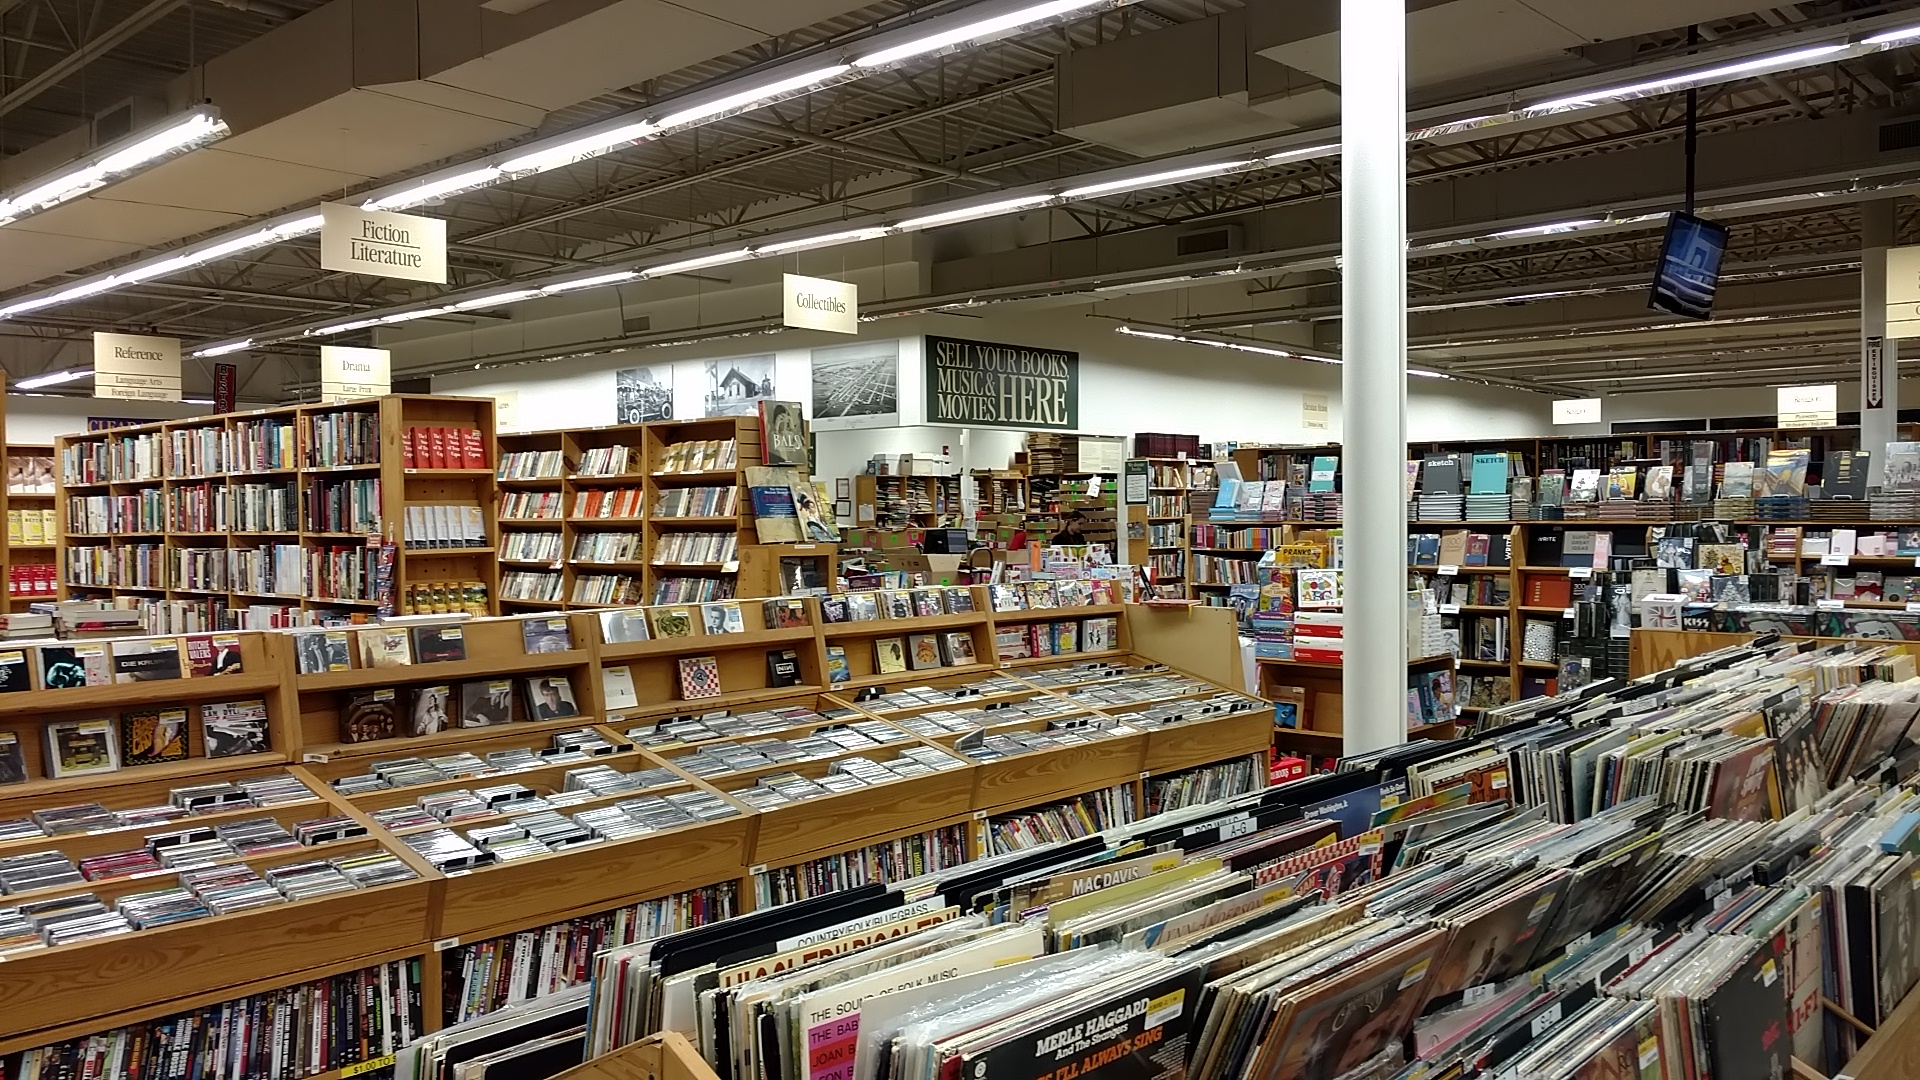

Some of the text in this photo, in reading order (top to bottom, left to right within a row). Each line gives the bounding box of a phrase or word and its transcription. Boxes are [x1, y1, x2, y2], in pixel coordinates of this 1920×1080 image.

[362, 220, 410, 245] Fiction
[350, 242, 422, 268] Literature
[796, 292, 846, 314] Collectibles
[114, 346, 163, 361] Reference
[936, 340, 1070, 380] SELL YOUR BOOKS,
[342, 360, 371, 372] Drama
[115, 376, 163, 386] Language Arts
[111, 388, 168, 399] Foreign Language
[937, 367, 1068, 426] MUSIC & HERE
[938, 394, 996, 422] MOVIES
[1427, 459, 1454, 467] sketch
[1283, 548, 1312, 556] PRANKS
[1302, 590, 1332, 601] ABC
[1684, 617, 1709, 627] KISS
[778, 664, 793, 672] NIN
[1230, 822, 1247, 837] A-G
[1072, 866, 1139, 896] MAC DAVIS
[810, 1008, 831, 1023] THE
[927, 967, 959, 984] MUSIC
[811, 1018, 860, 1044] THE BAB
[1035, 997, 1150, 1057] MERLE HAGGARD
[1055, 1023, 1129, 1061] And The Strangers
[1056, 1026, 1163, 1080] I'LL ALWAYS SING
[169, 1051, 180, 1077] BOSSES
[177, 1050, 189, 1076] BOSSES
[353, 1061, 377, 1074] $1.00
[378, 1058, 390, 1067] TO
[812, 1047, 843, 1068] JOAN
